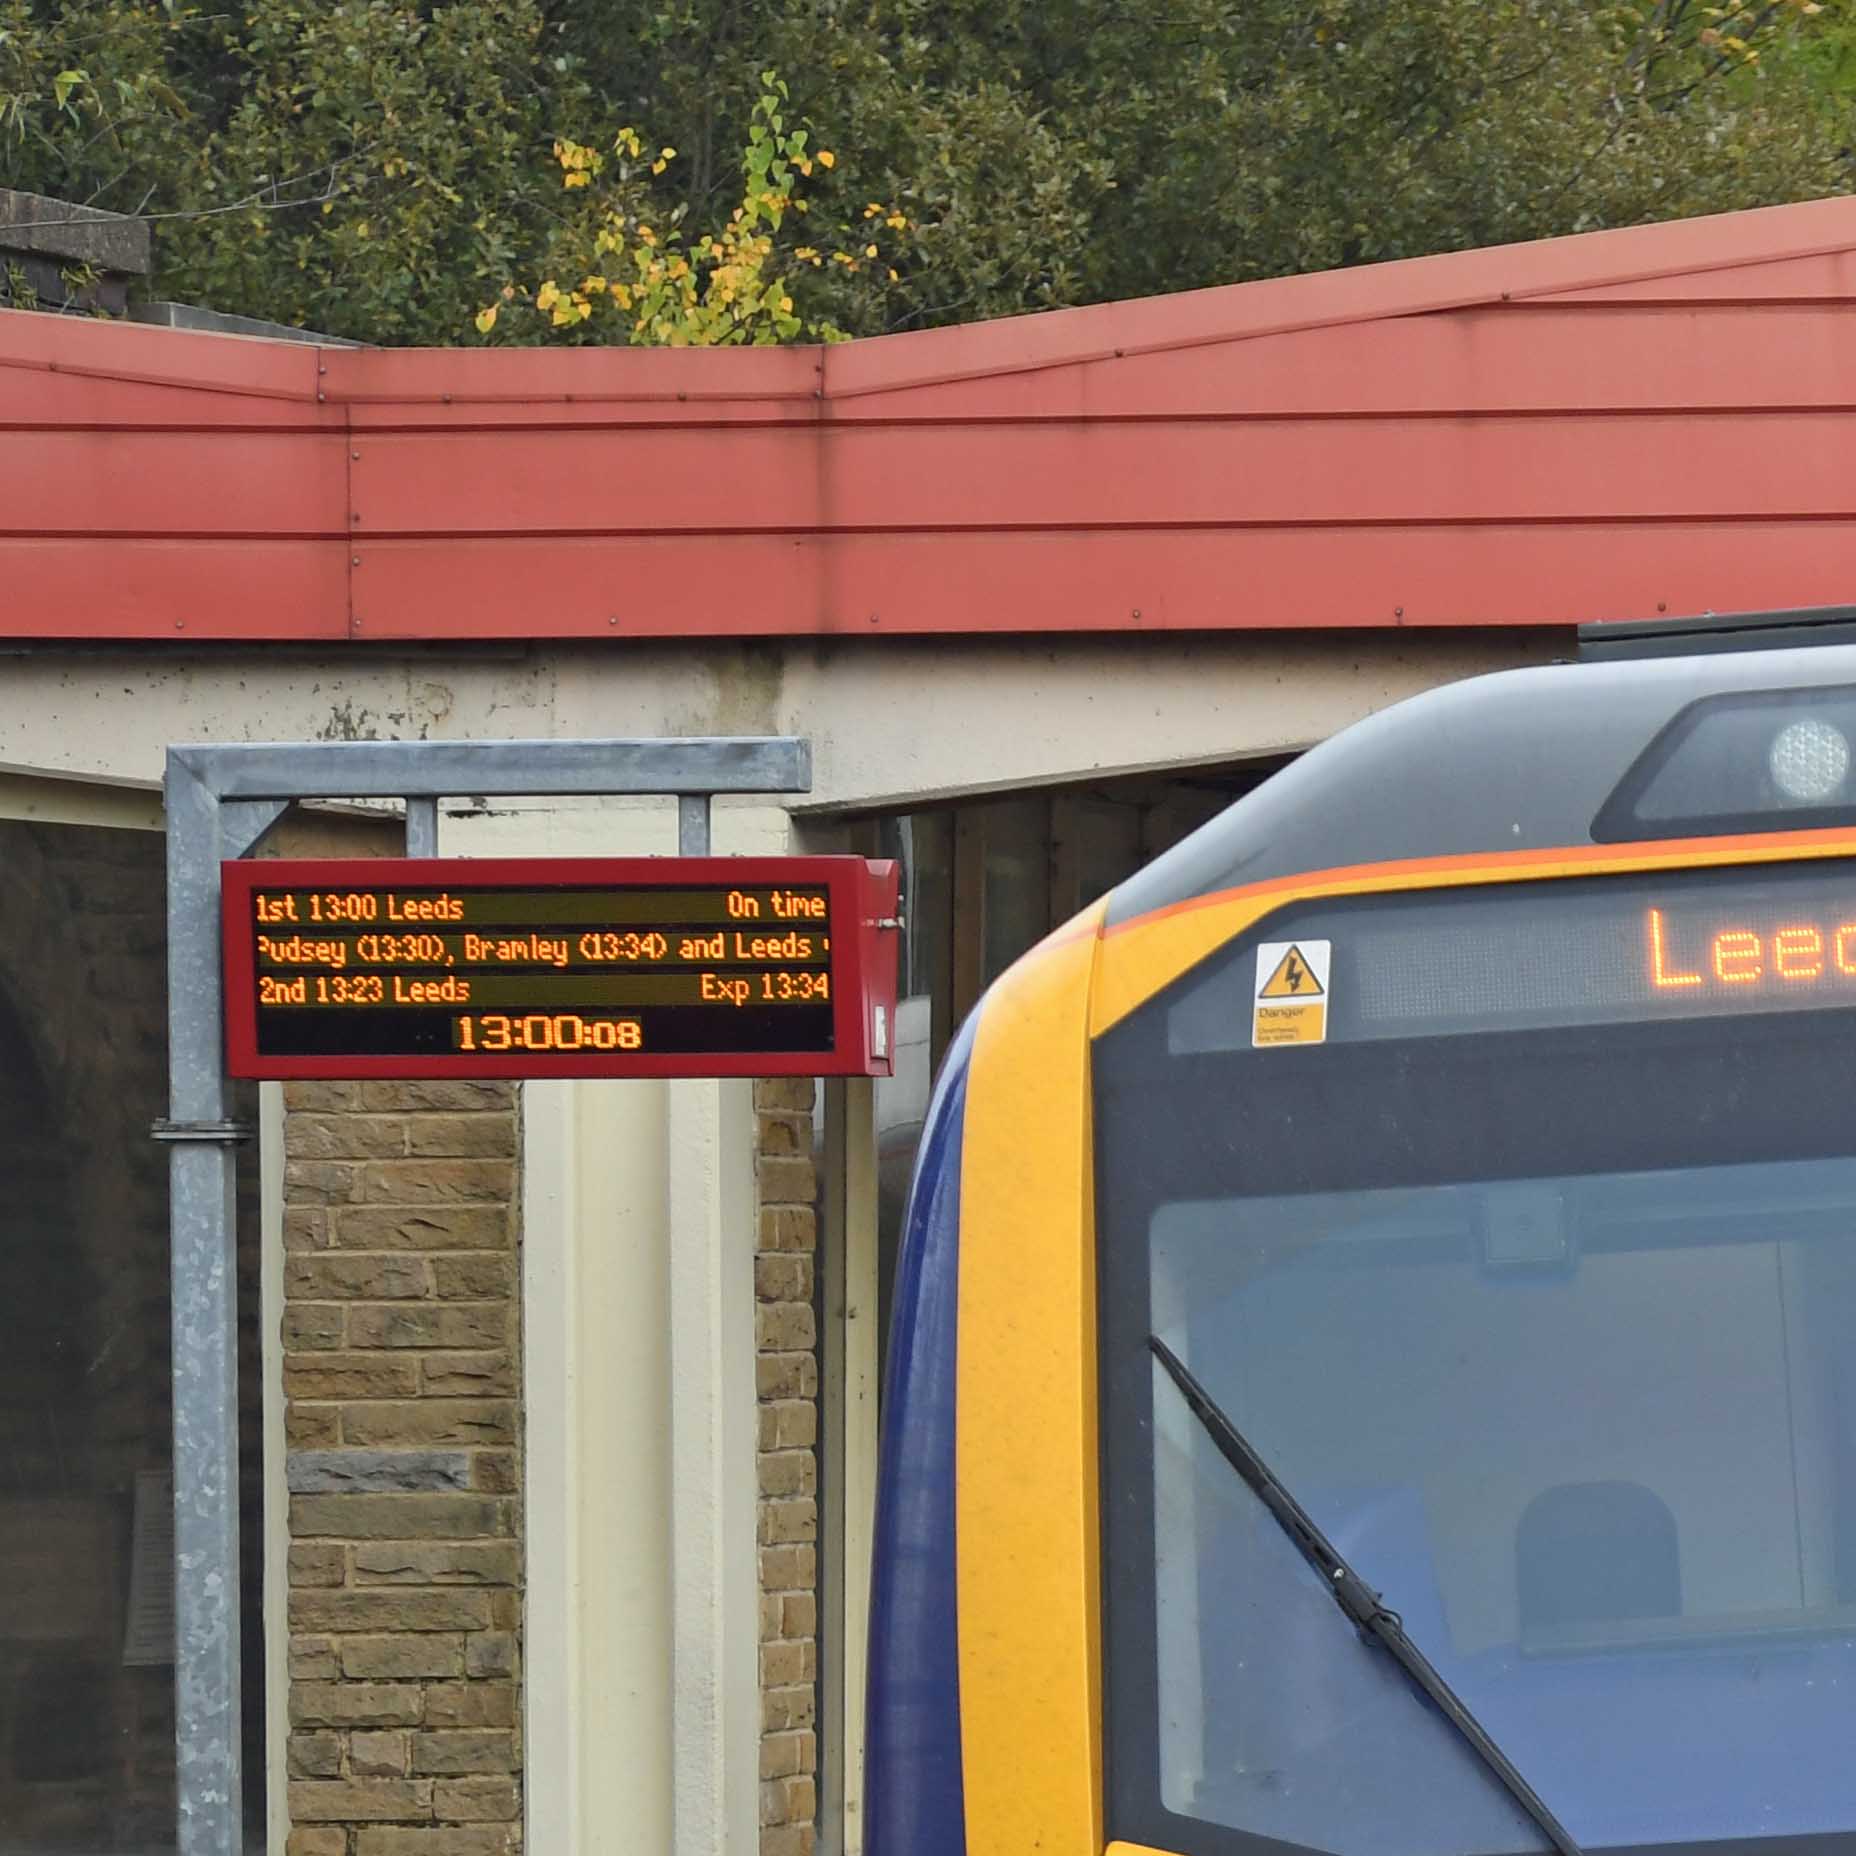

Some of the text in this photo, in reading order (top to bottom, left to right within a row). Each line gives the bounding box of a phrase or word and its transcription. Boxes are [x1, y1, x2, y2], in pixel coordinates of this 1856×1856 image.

[256, 890, 827, 922] 1st 13:00 Leeds On time
[357, 934, 455, 967] (13:30),
[464, 933, 569, 968] Bramley
[579, 932, 668, 961] (13:34)
[679, 931, 726, 960] and
[735, 931, 812, 960] Leeds
[259, 972, 829, 1006] 2nd 13:23 Leeds Exp 13:34
[457, 1014, 642, 1050] 13:00:08
